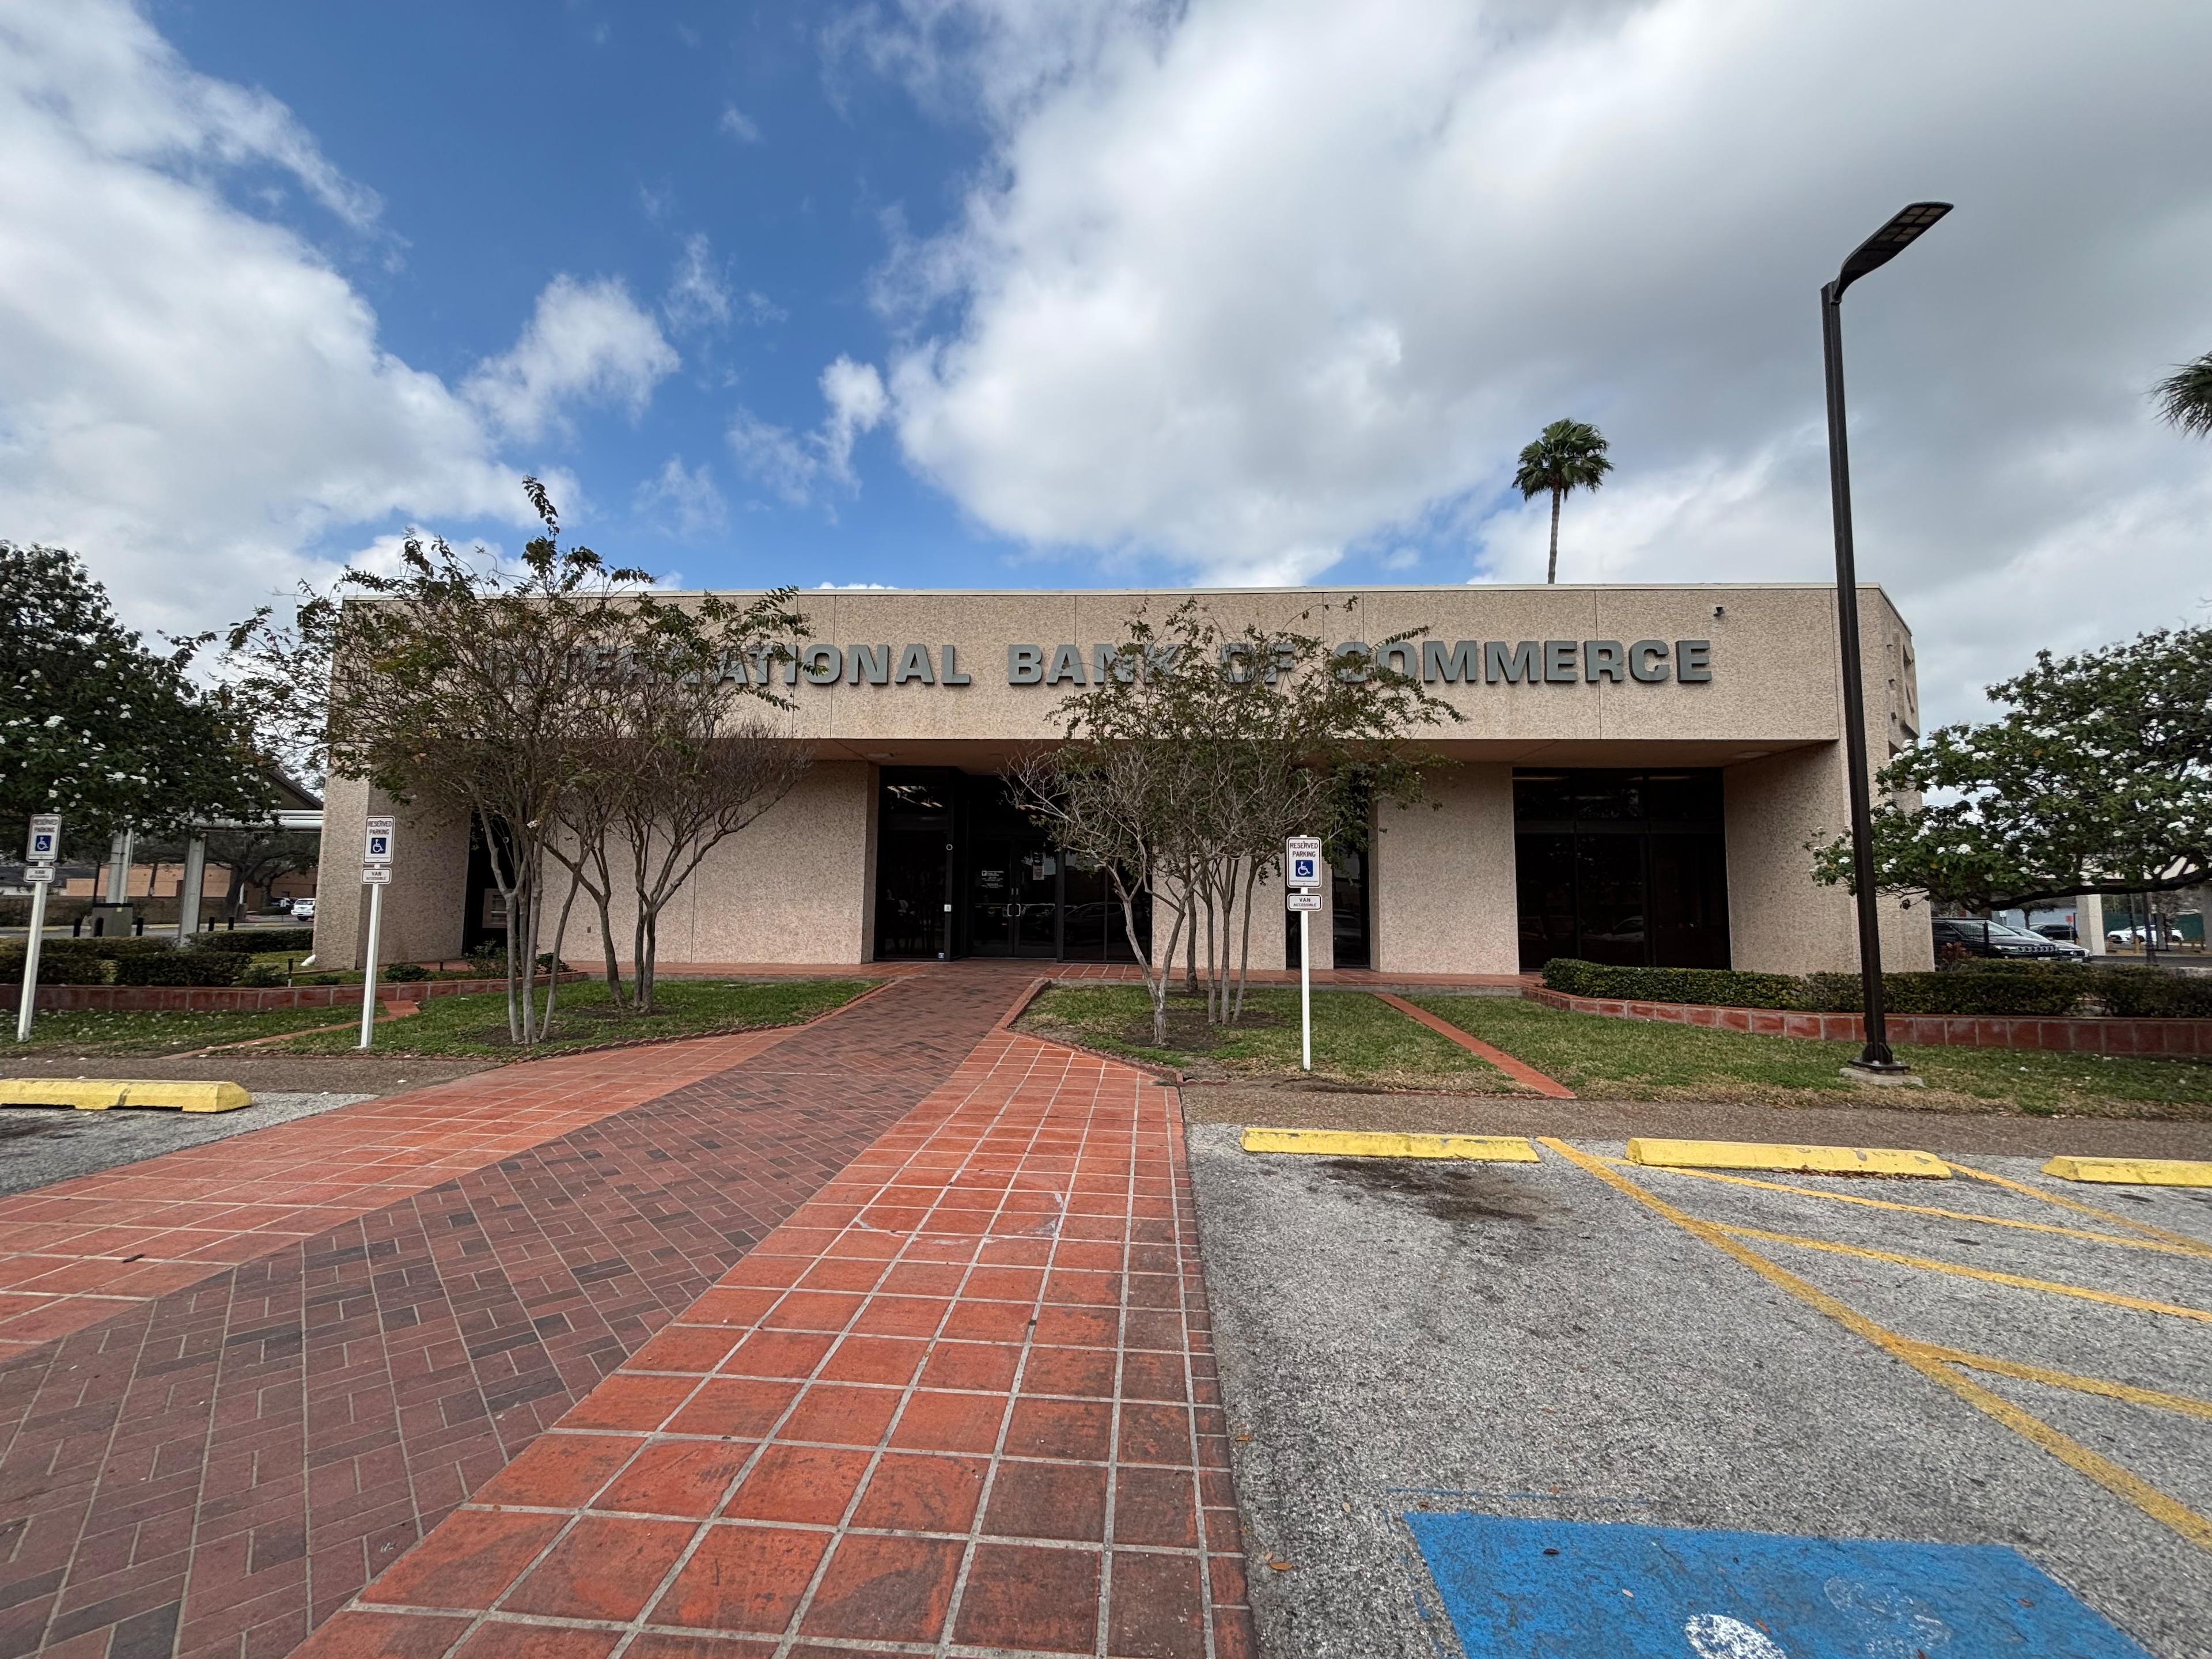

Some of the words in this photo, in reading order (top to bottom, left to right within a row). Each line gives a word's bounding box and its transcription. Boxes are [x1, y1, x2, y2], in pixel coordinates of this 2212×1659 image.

[1008, 643, 1185, 685] BANK
[1219, 642, 1294, 684] OF
[1334, 640, 1713, 683] COMMERCE
